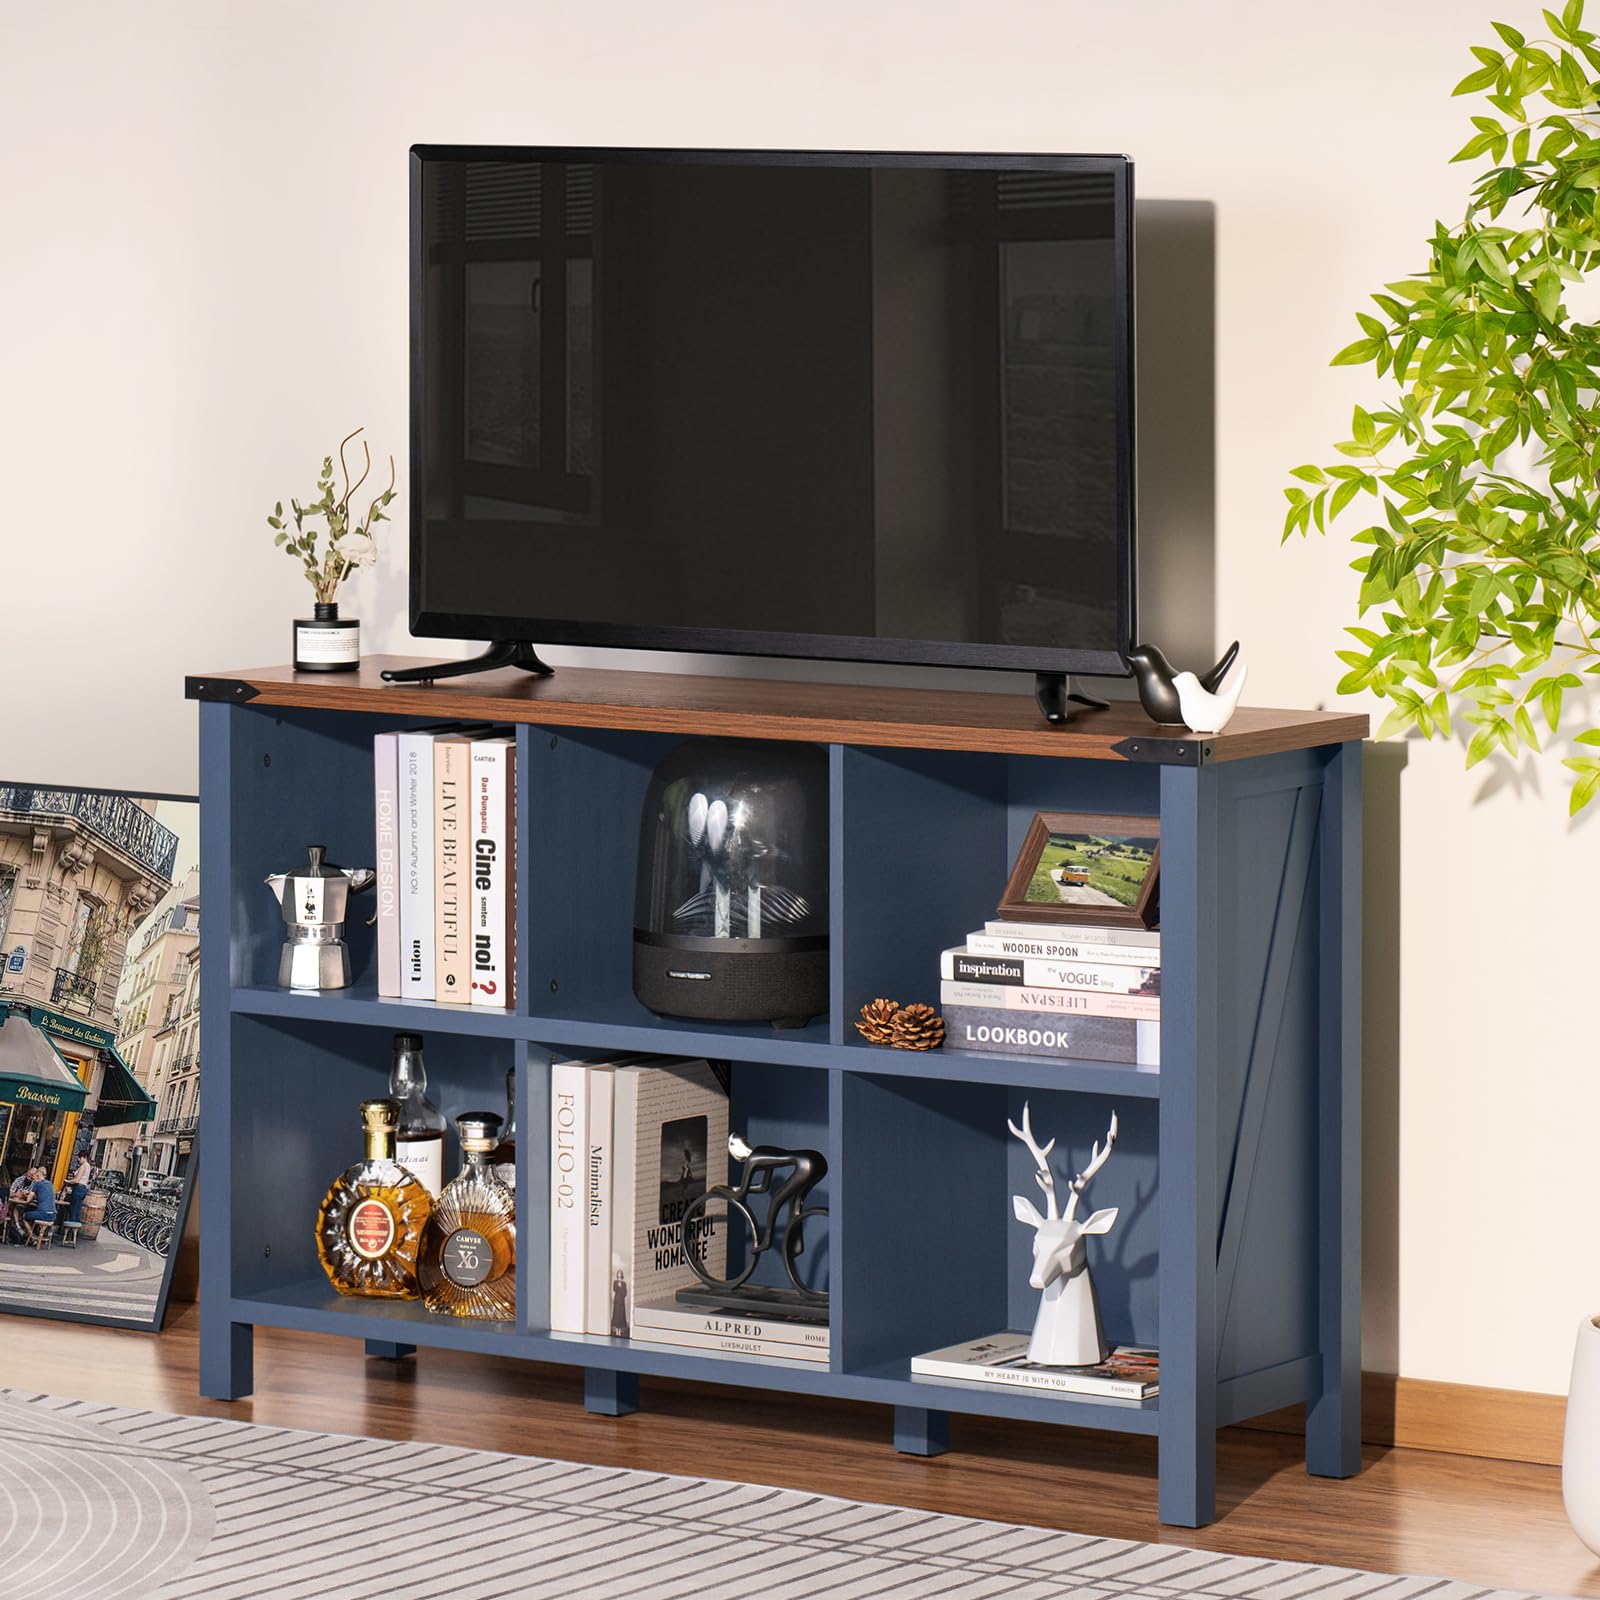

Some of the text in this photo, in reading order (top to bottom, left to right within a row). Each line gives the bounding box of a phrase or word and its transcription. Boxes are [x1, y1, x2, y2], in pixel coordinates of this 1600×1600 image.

[409, 752, 418, 775] 2018
[409, 778, 418, 807] Winter
[480, 776, 489, 834] Dan Dungaciu
[378, 790, 393, 844] HOME
[409, 808, 418, 829] and
[410, 831, 419, 869] Autumn
[442, 781, 458, 962] LIVE BEAUTIFUL
[475, 838, 497, 891] Cine
[411, 939, 421, 982] Union
[475, 934, 496, 972] noi
[1002, 942, 1043, 955] WOODEN
[1046, 945, 1079, 957] SPOON
[959, 961, 1021, 977] inspiration
[1058, 971, 1099, 986] VOGUE
[1020, 993, 1087, 1009] LIFESPAN
[965, 1025, 1069, 1049] LOOKBOOK
[15, 1085, 61, 1105] Brasserie
[557, 1093, 575, 1209] FOLIO-02
[590, 1145, 603, 1227] Minimalista
[647, 1216, 716, 1249] WONDRFUL
[457, 1250, 479, 1269] XO
[655, 1240, 708, 1271] HOMEIFE
[704, 1320, 762, 1336] ALPRED
[804, 1334, 826, 1343] HOME
[996, 1372, 1020, 1381] HEART
[1022, 1375, 1029, 1383] IS
[1031, 1377, 1049, 1385] WITH
[1051, 1378, 1066, 1387] YOU
